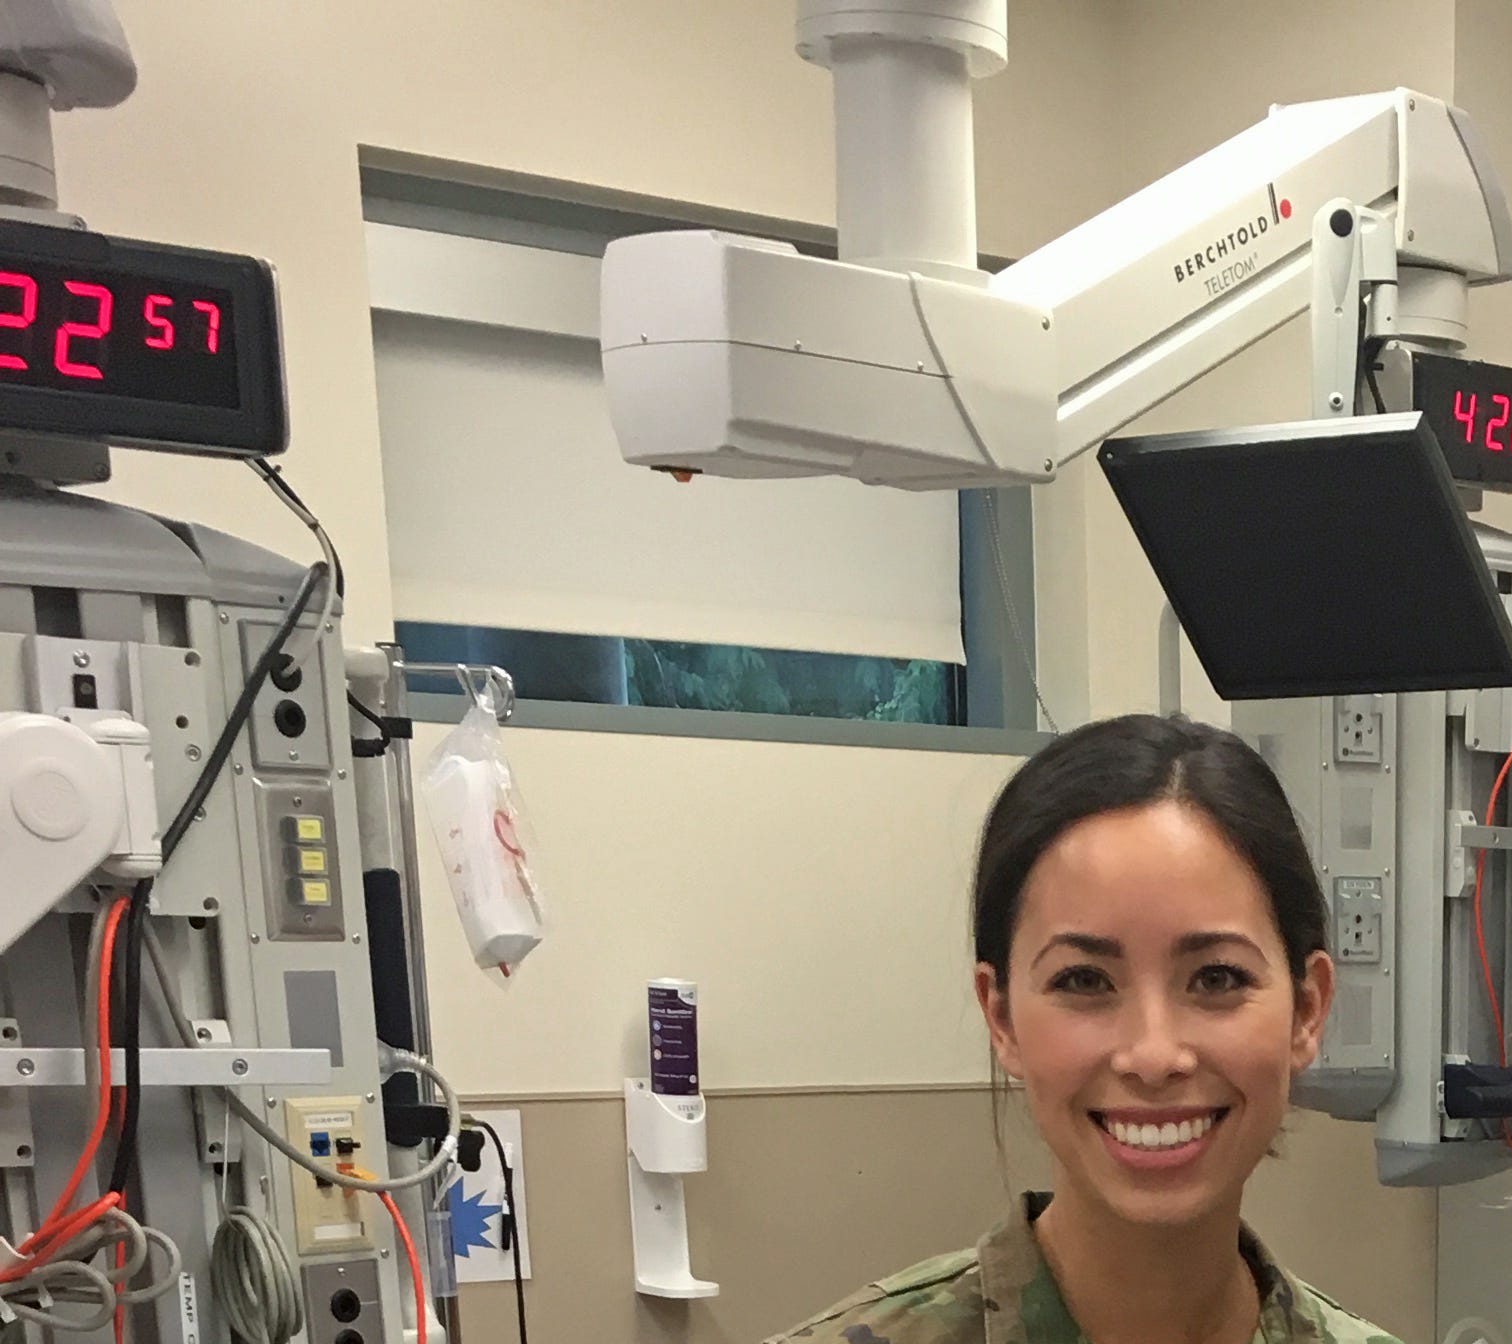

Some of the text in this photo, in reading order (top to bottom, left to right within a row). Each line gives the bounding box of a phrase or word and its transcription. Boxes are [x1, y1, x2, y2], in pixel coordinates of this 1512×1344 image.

[1174, 216, 1268, 283] BERCHTOLD
[144, 294, 220, 353] 57
[183, 1274, 194, 1323] TEMP
